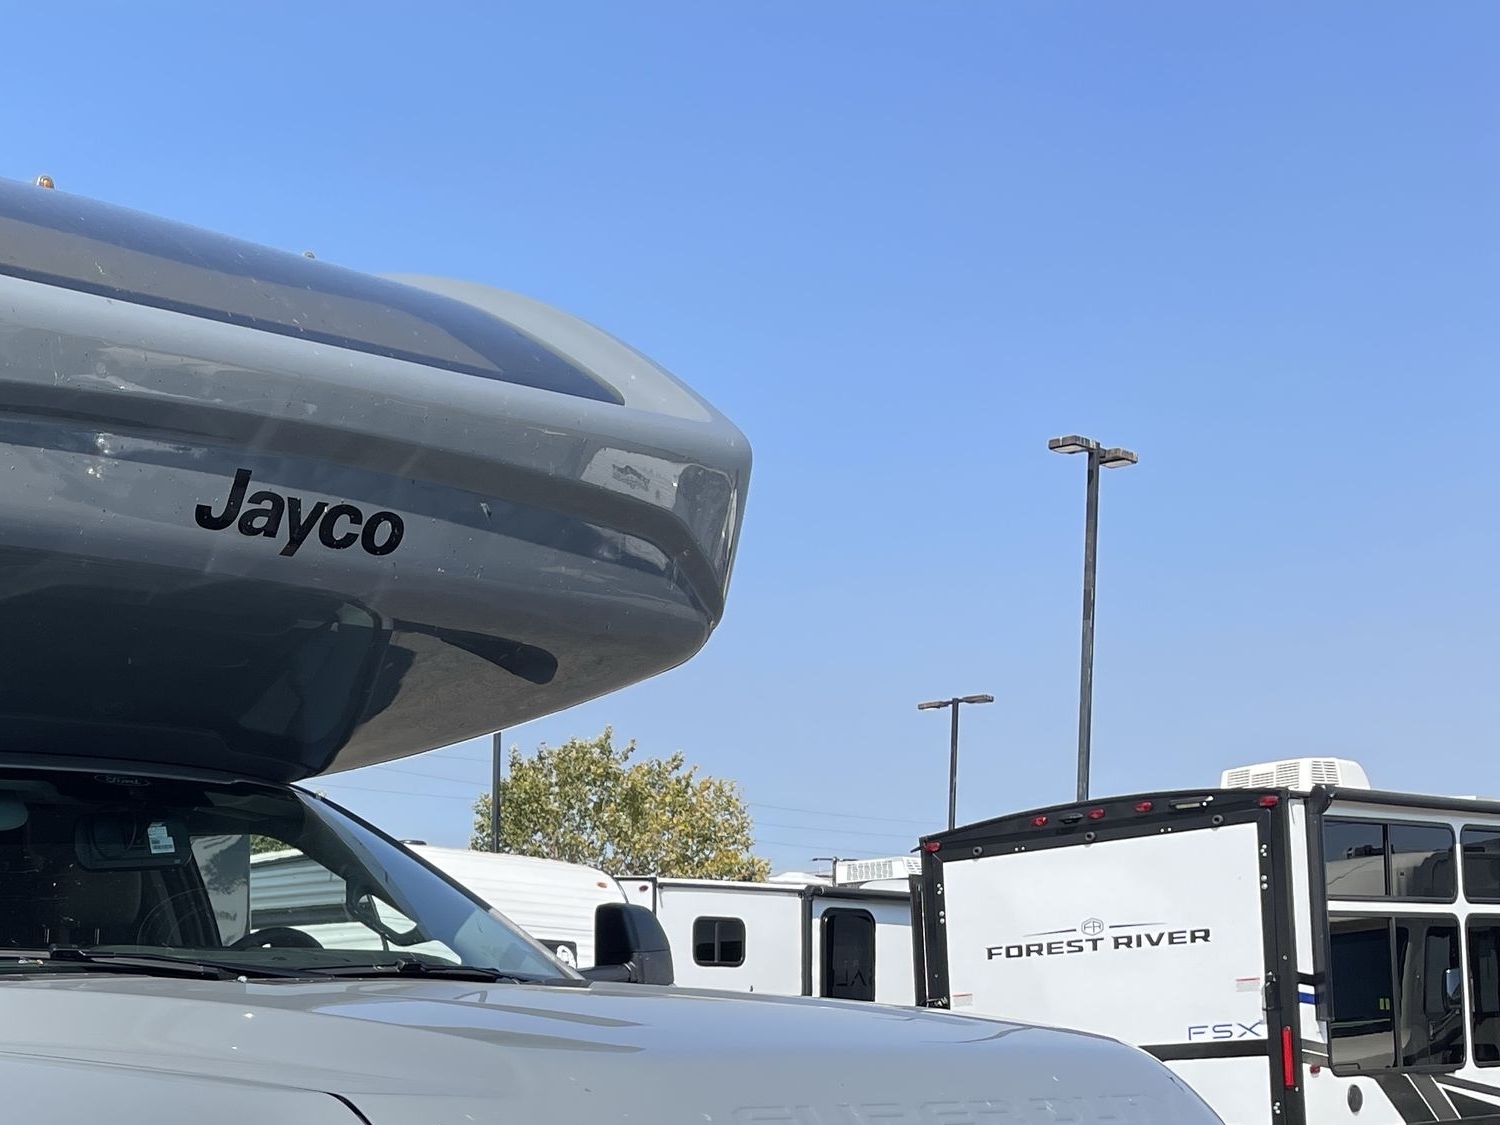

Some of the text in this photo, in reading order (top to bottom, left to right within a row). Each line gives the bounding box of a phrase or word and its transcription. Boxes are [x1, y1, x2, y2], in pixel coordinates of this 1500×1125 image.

[195, 468, 405, 557] Jayco
[986, 928, 1211, 960] FOREST RIVER
[1188, 1019, 1263, 1040] FSX
